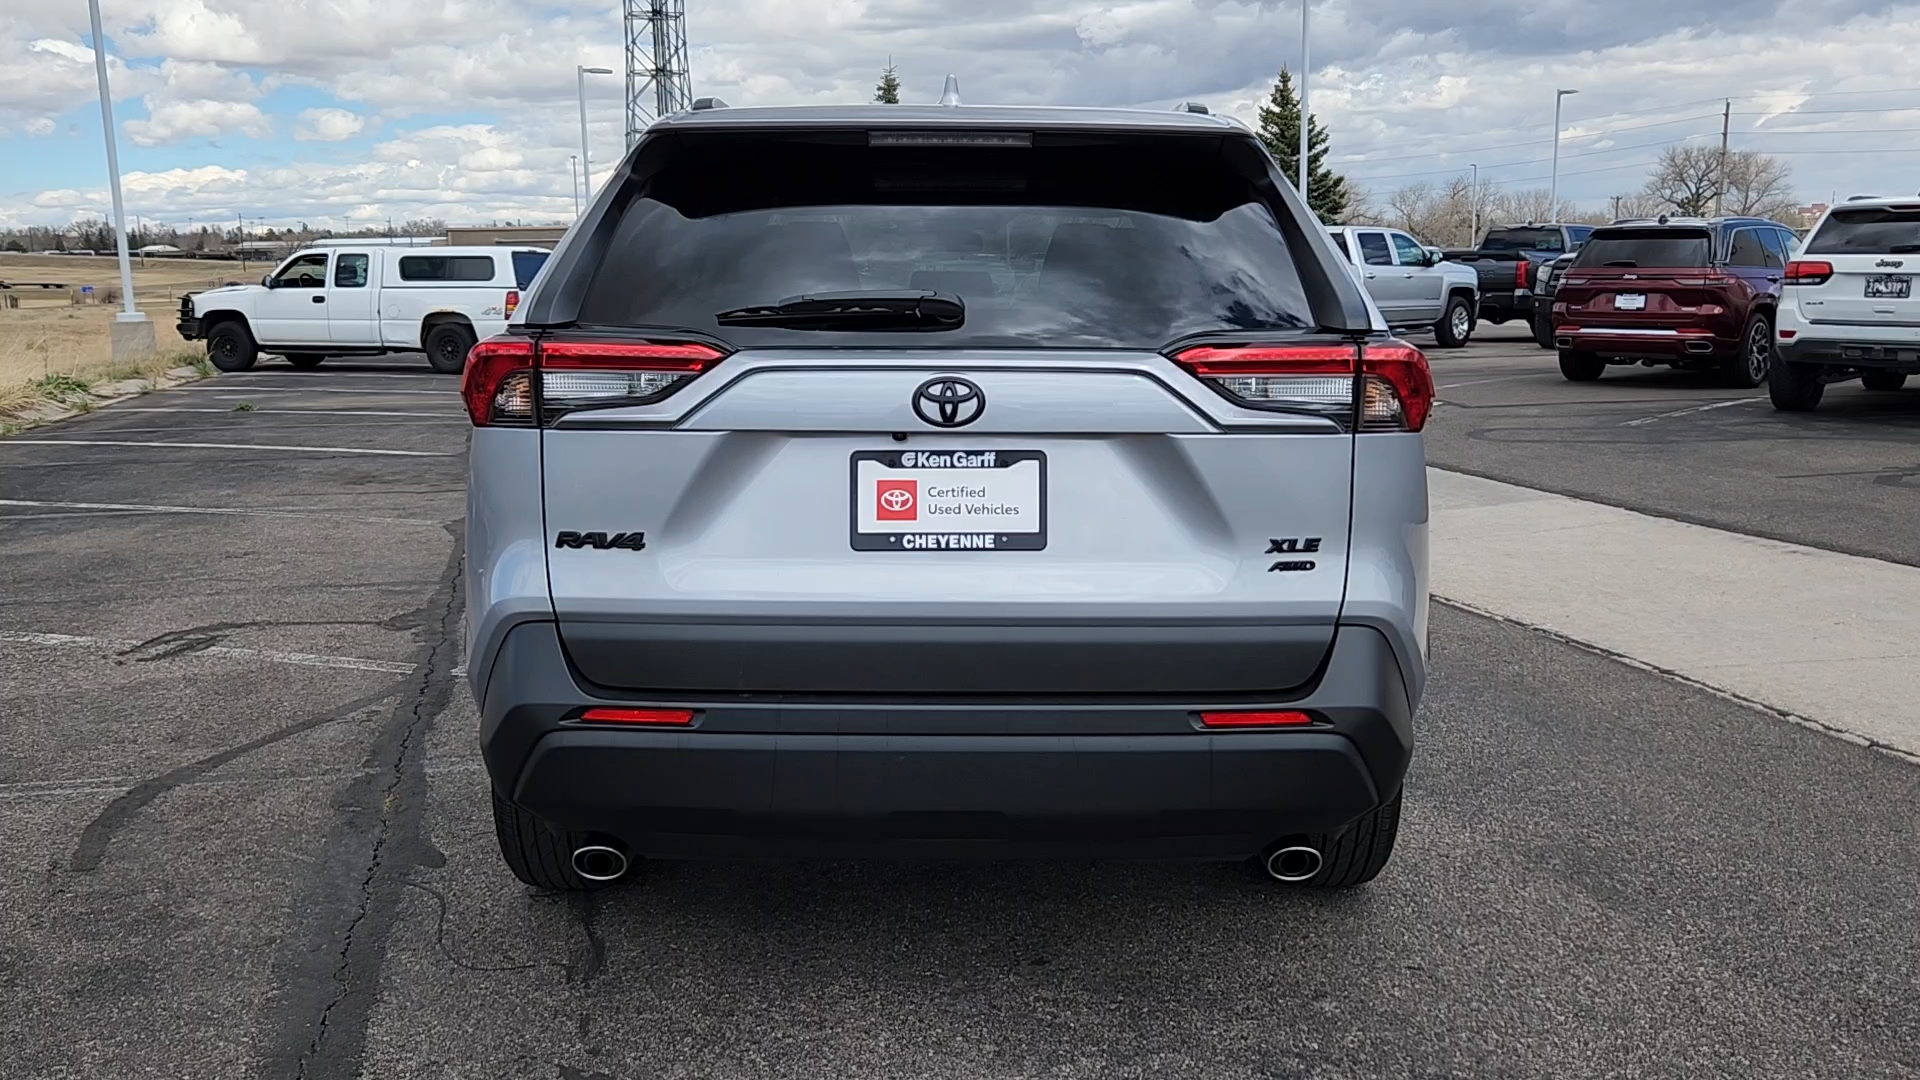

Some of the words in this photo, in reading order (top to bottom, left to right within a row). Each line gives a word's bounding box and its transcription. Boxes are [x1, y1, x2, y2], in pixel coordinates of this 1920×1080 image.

[917, 452, 951, 468] Ken
[952, 452, 997, 468] Garff
[927, 486, 987, 499] Certified
[927, 503, 962, 516] Used
[965, 503, 1021, 516] Vehicles
[555, 531, 646, 552] RAV4
[902, 534, 996, 549] CHEYENNE
[1264, 537, 1323, 555] XLE
[1267, 560, 1317, 573] AWD
